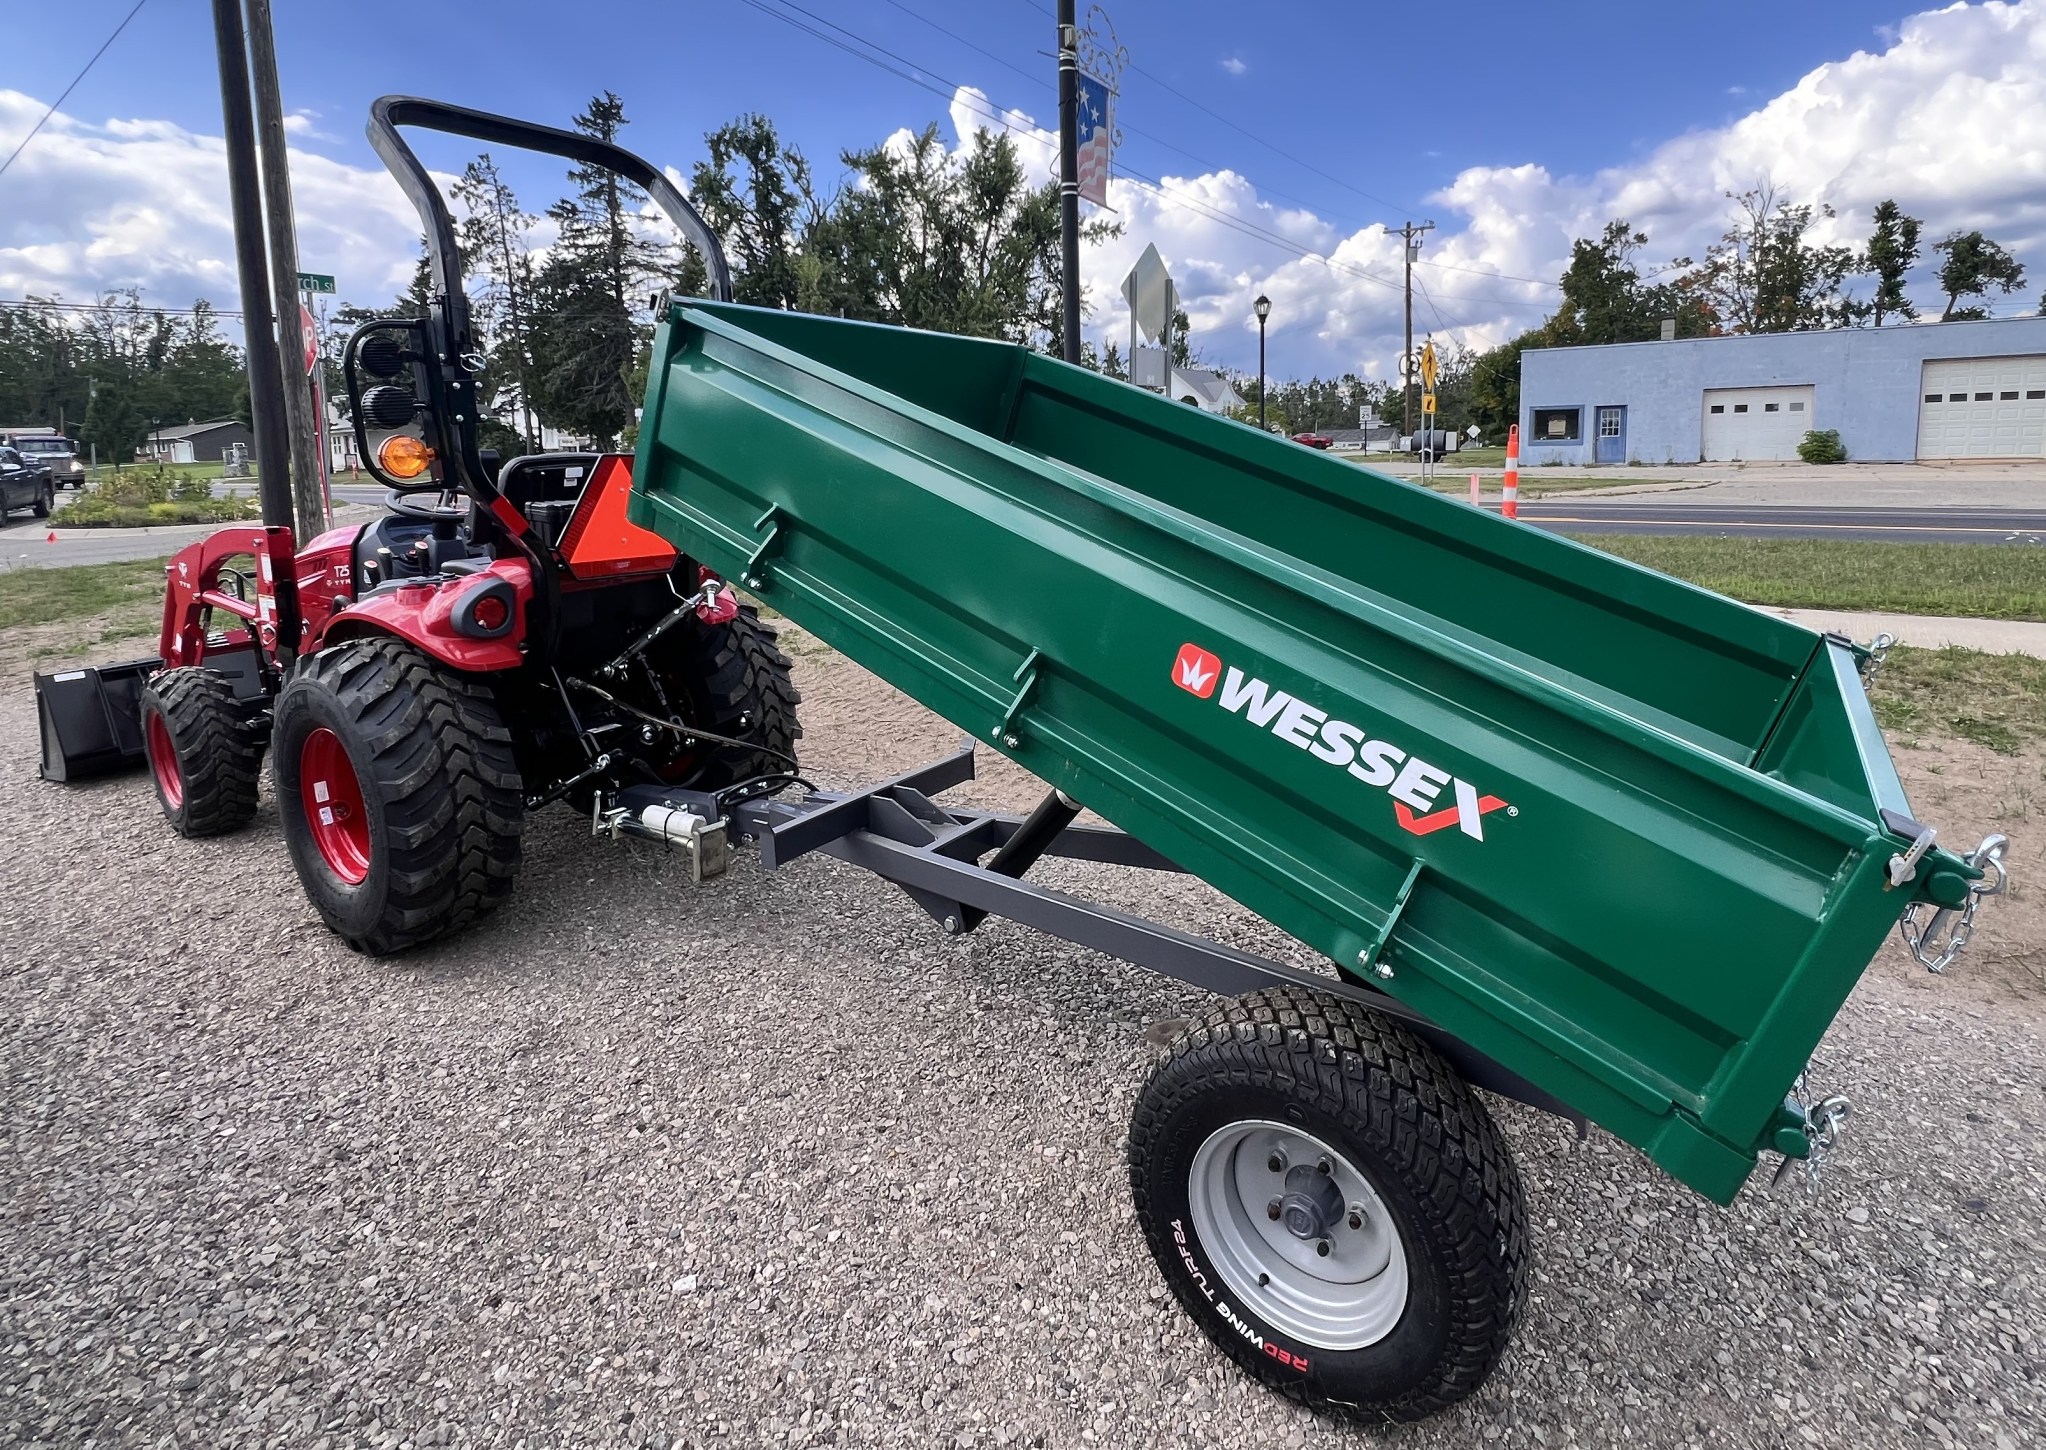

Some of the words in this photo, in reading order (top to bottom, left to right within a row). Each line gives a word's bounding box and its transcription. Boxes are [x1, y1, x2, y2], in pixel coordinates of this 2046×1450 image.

[297, 275, 320, 290] rch
[333, 564, 350, 577] T25
[1219, 665, 1508, 842] WESSEX
[1215, 1301, 1310, 1373] REDWING
